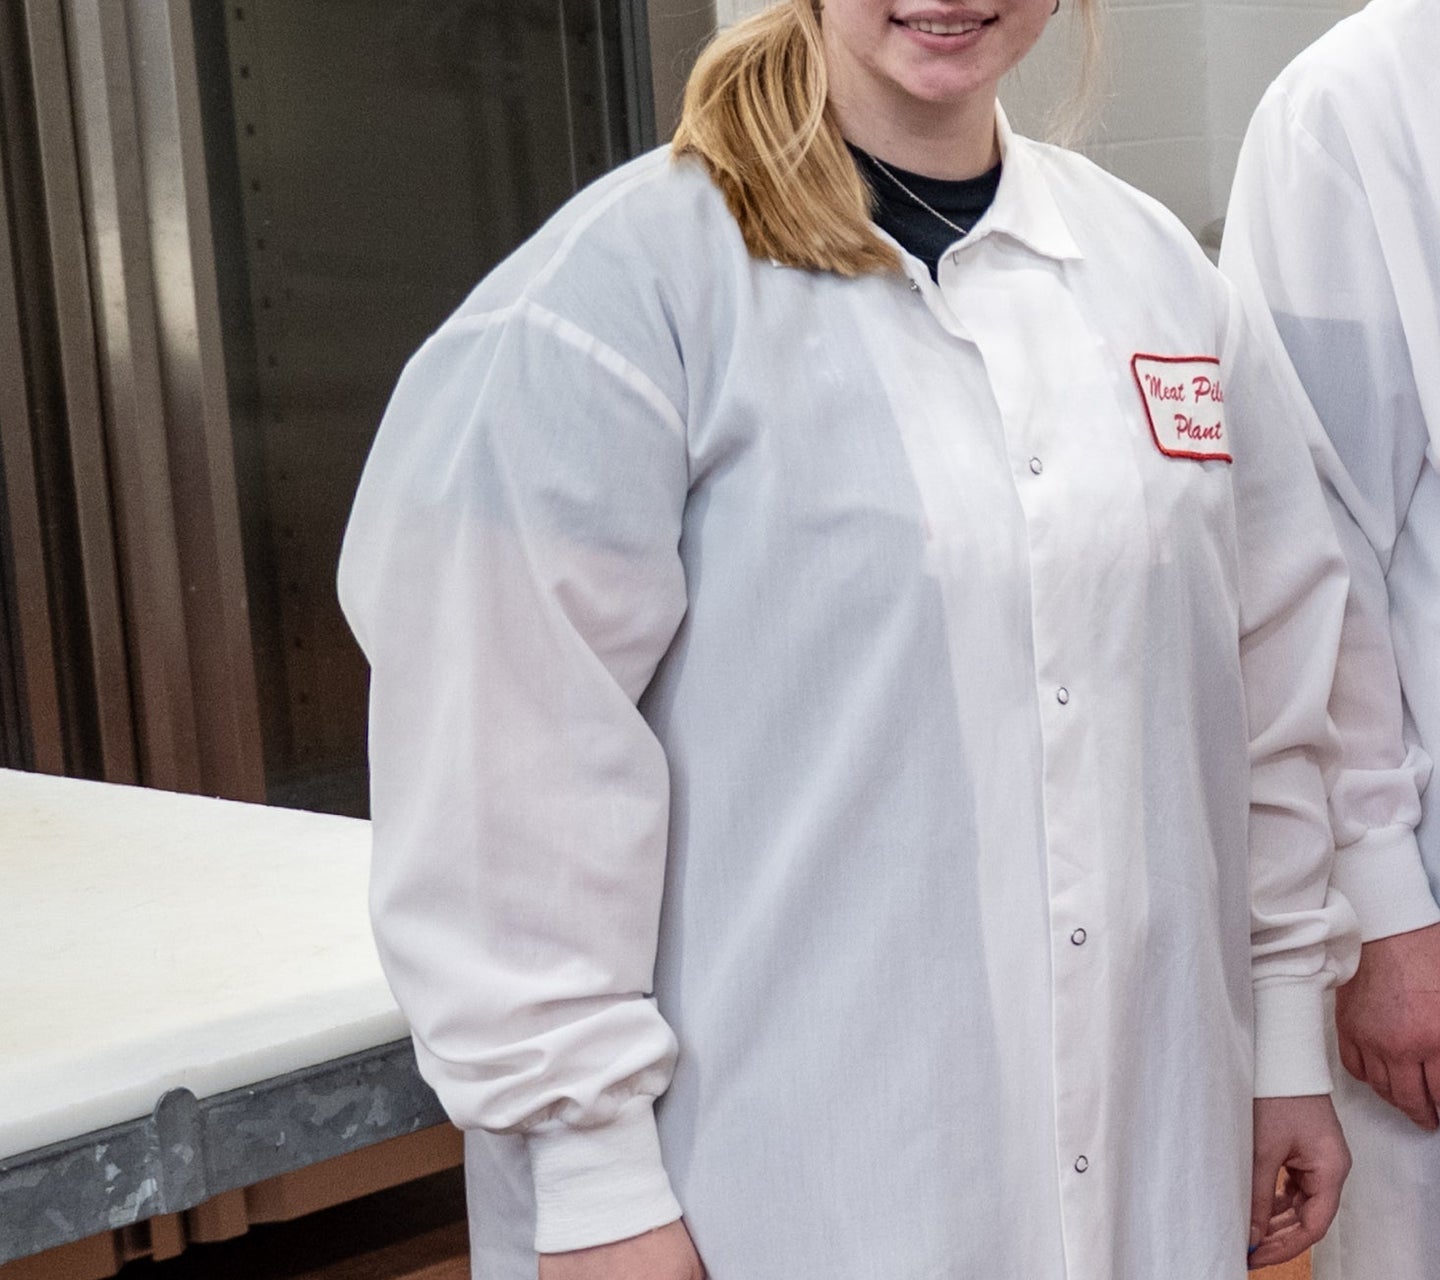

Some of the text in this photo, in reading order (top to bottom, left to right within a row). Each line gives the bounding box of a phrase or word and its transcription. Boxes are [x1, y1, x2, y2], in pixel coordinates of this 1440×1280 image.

[1145, 374, 1224, 404] Meat Pil
[1174, 414, 1223, 440] Plant
